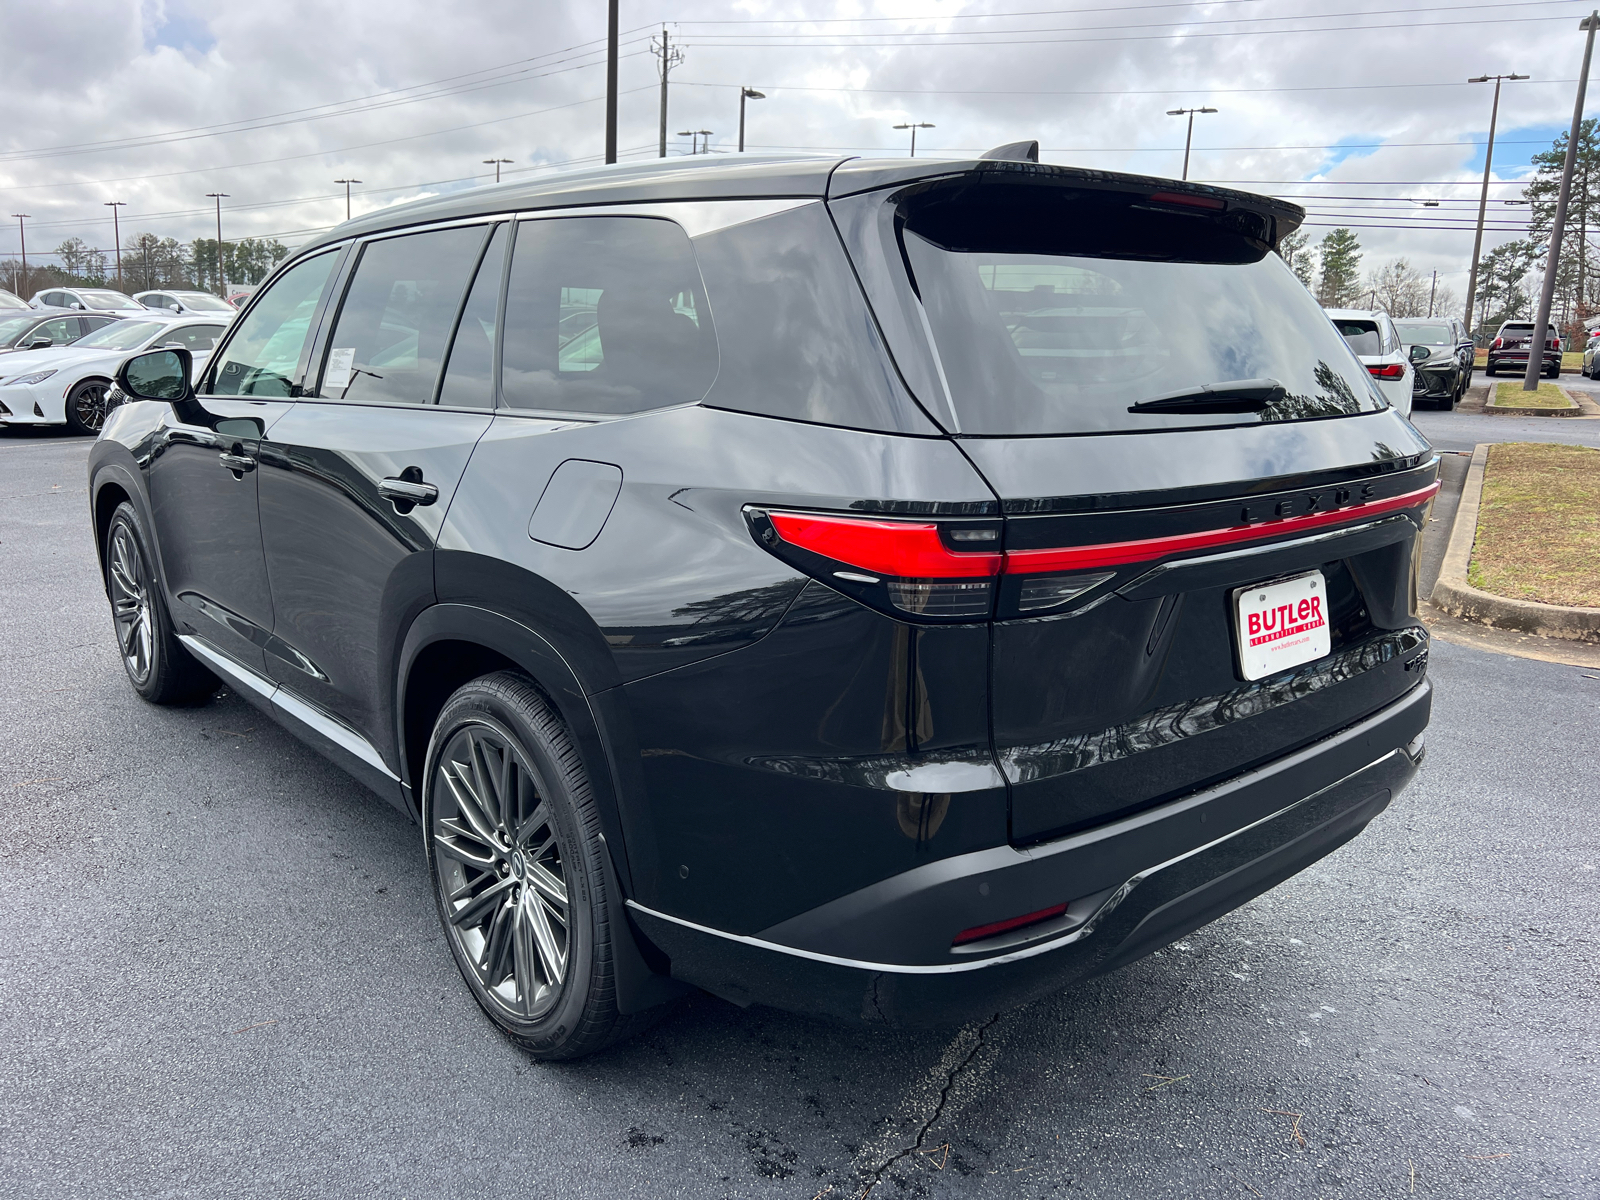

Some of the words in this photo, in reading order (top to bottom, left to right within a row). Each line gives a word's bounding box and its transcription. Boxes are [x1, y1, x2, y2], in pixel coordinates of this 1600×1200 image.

[1240, 484, 1376, 522] LEXUS
[1250, 627, 1297, 647] AUTOMOTIVE
[1302, 619, 1325, 631] GROUP
